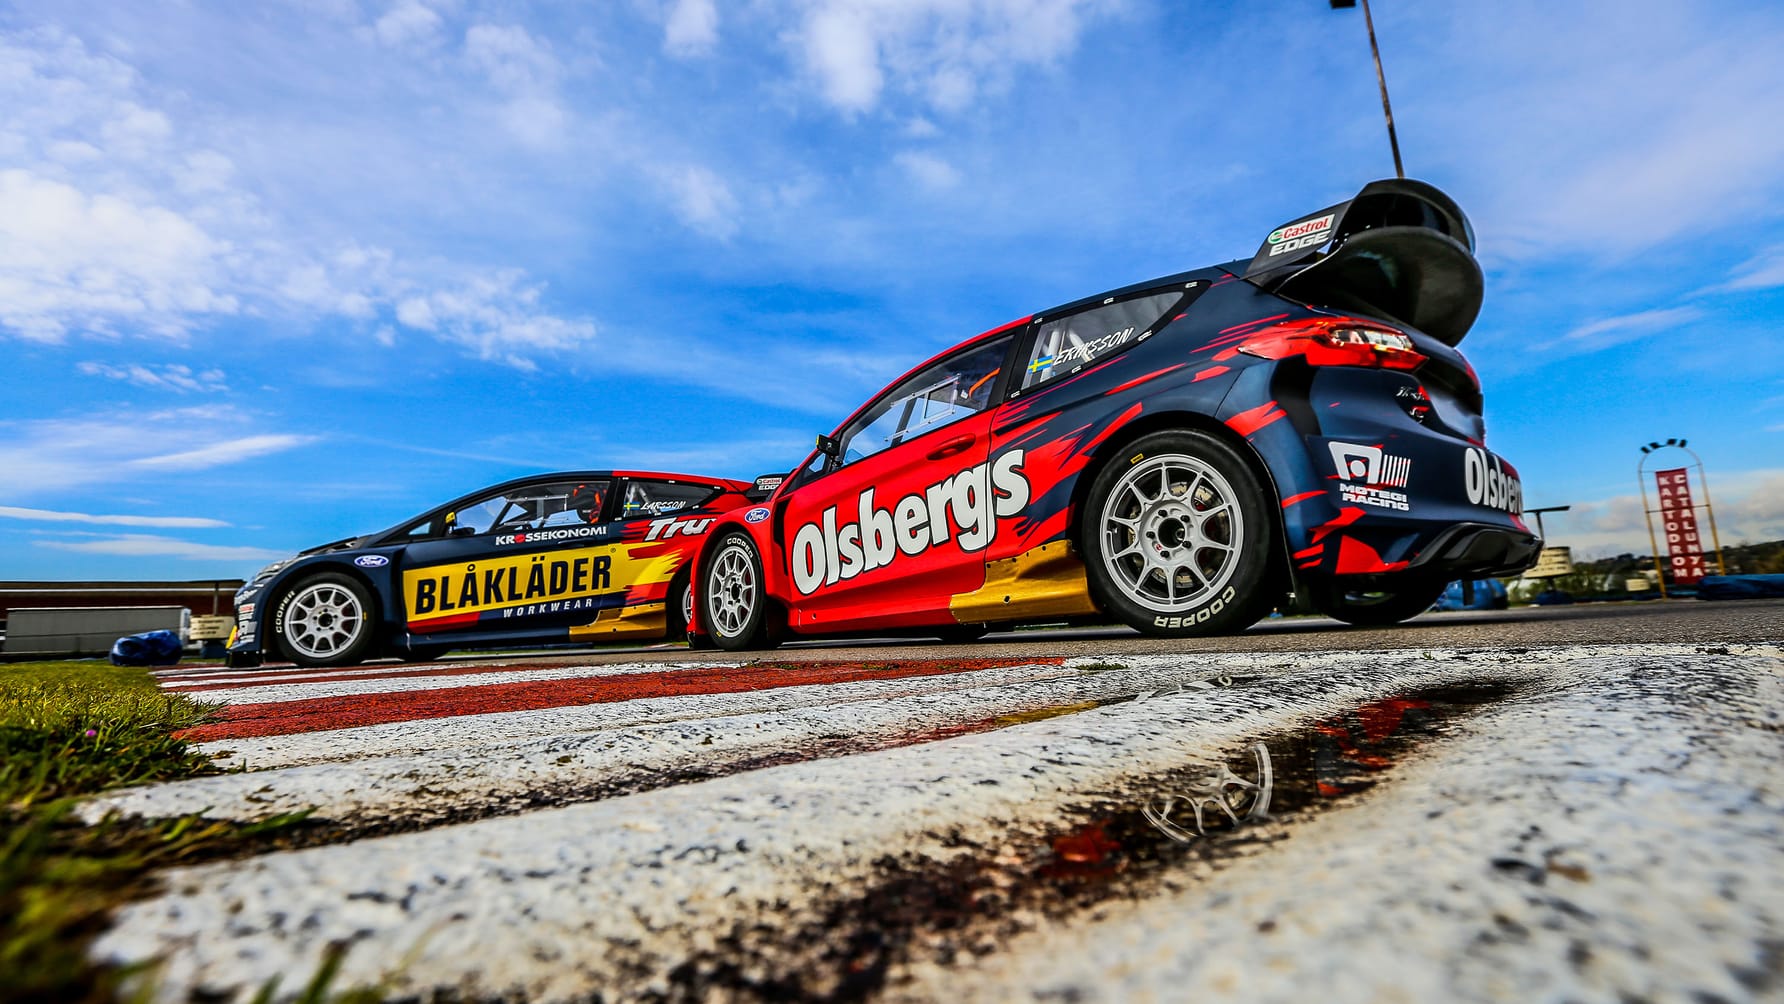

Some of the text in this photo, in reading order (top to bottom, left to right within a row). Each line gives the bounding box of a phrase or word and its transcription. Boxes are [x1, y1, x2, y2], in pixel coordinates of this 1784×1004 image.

[1283, 218, 1329, 239] Castrol
[1268, 229, 1332, 257] EDGE
[1053, 326, 1135, 367] ERIKSSON
[1339, 483, 1408, 502] MOTEGI
[1342, 493, 1410, 511] RACING
[640, 501, 686, 510] LARSSON
[747, 509, 769, 522] Ford
[644, 517, 717, 542] Tru
[792, 449, 1029, 594] Olsbergs
[1674, 474, 1704, 576] CATALUNYA
[495, 526, 607, 546] KROSSEKONOMI
[726, 537, 754, 559] COOPER
[357, 556, 387, 567] Ford
[415, 555, 611, 615] BLÅKLÄDER
[275, 590, 296, 633] COOPER
[503, 598, 593, 618] WORKWEAR
[1153, 586, 1236, 629] COOPER
